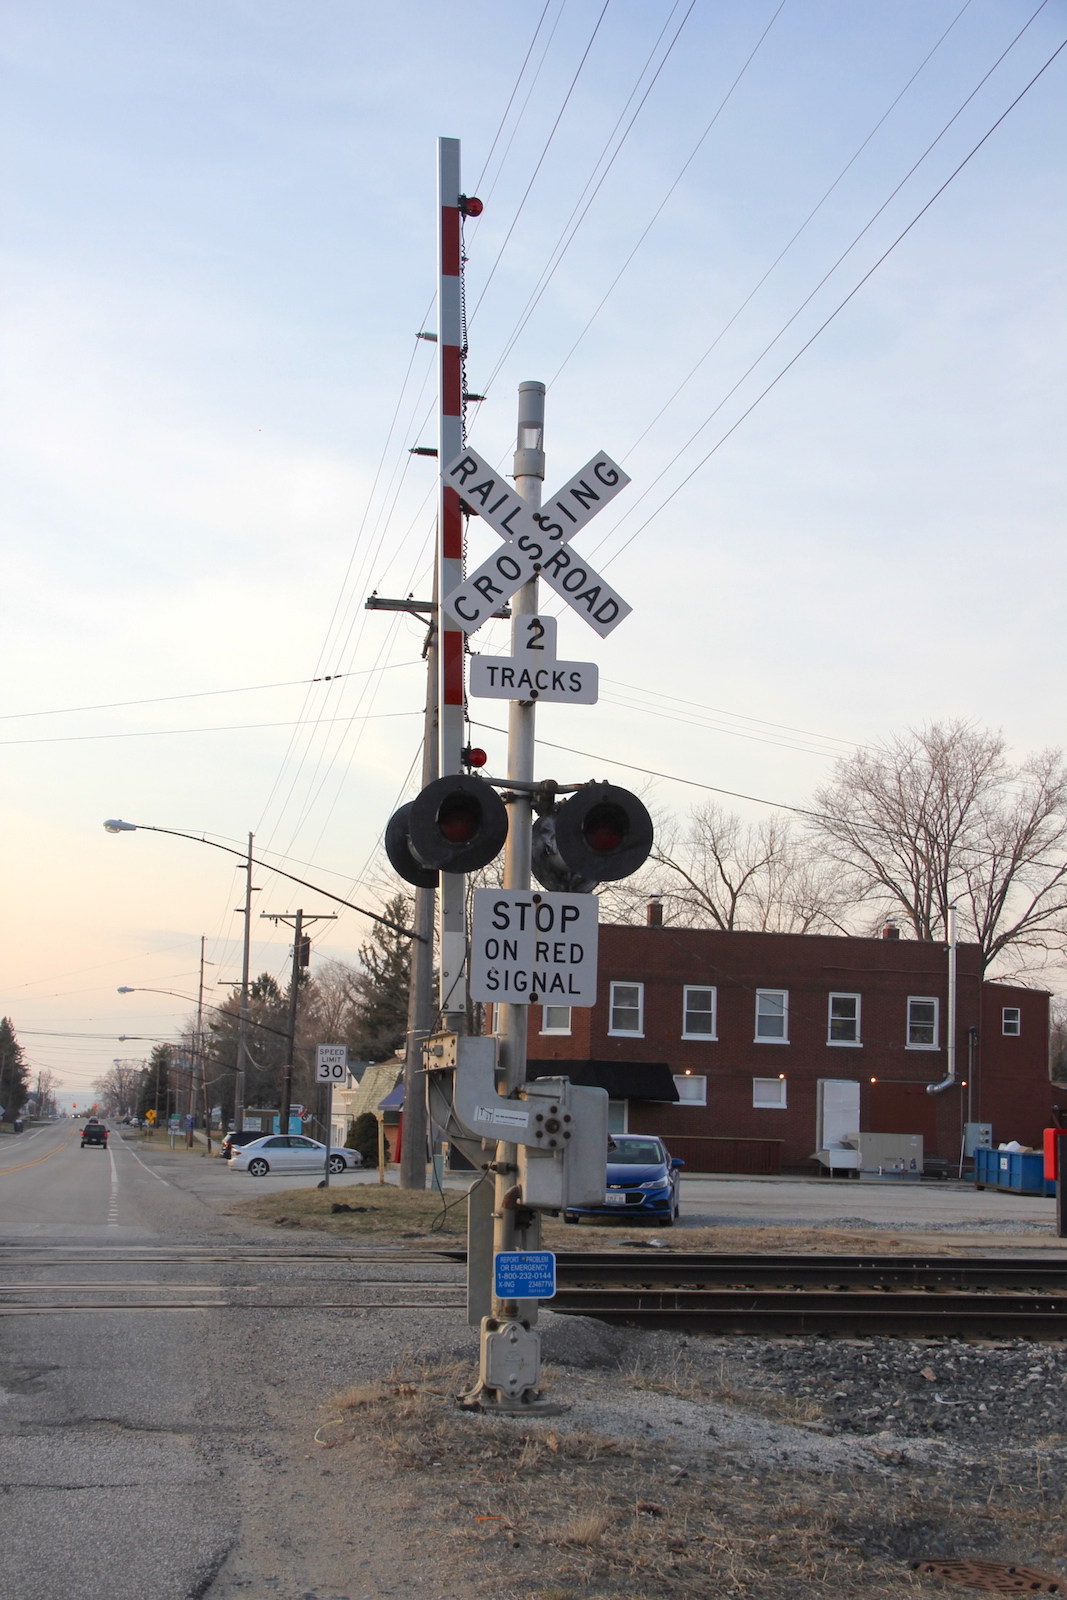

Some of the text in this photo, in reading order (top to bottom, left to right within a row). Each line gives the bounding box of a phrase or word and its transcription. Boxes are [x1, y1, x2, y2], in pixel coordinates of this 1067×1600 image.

[454, 461, 619, 621] CROSSING
[526, 621, 545, 650] 2
[486, 666, 582, 692] TRACKS
[491, 901, 580, 933] STOP
[485, 938, 584, 964] ON RED
[486, 966, 581, 995] SIGNAL
[319, 1064, 343, 1078] 30
